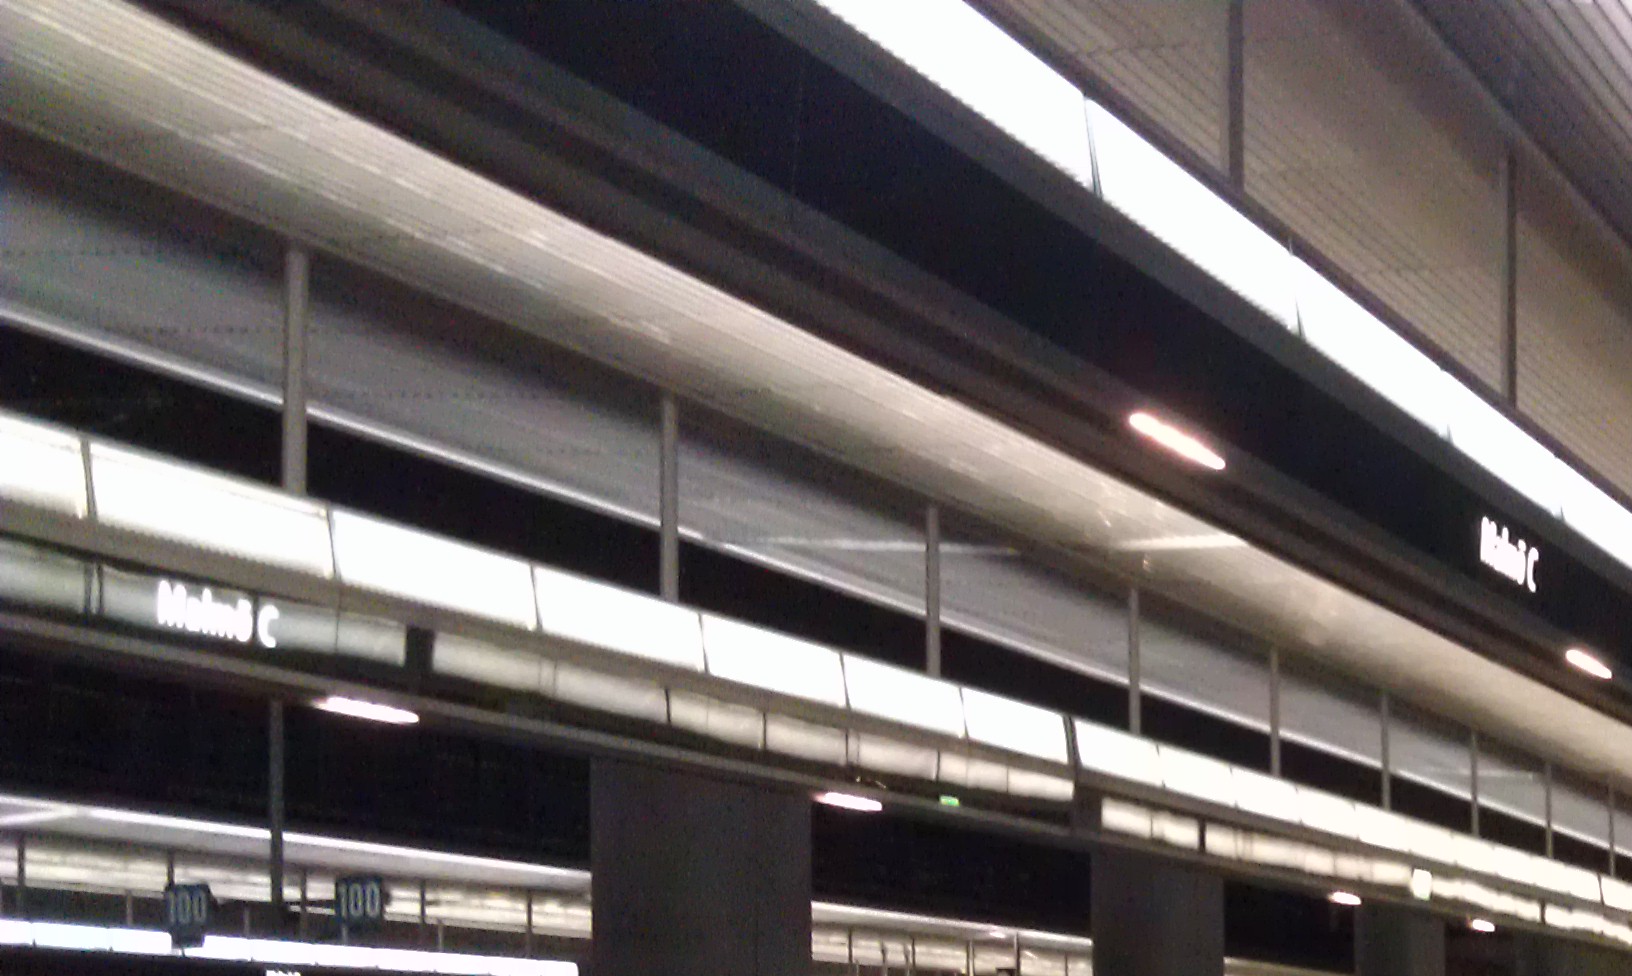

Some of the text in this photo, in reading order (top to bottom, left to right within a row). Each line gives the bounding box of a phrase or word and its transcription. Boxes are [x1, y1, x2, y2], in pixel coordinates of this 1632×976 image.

[1527, 546, 1539, 594] C
[258, 604, 280, 649] C
[168, 888, 207, 925] 100
[339, 880, 380, 918] 100
